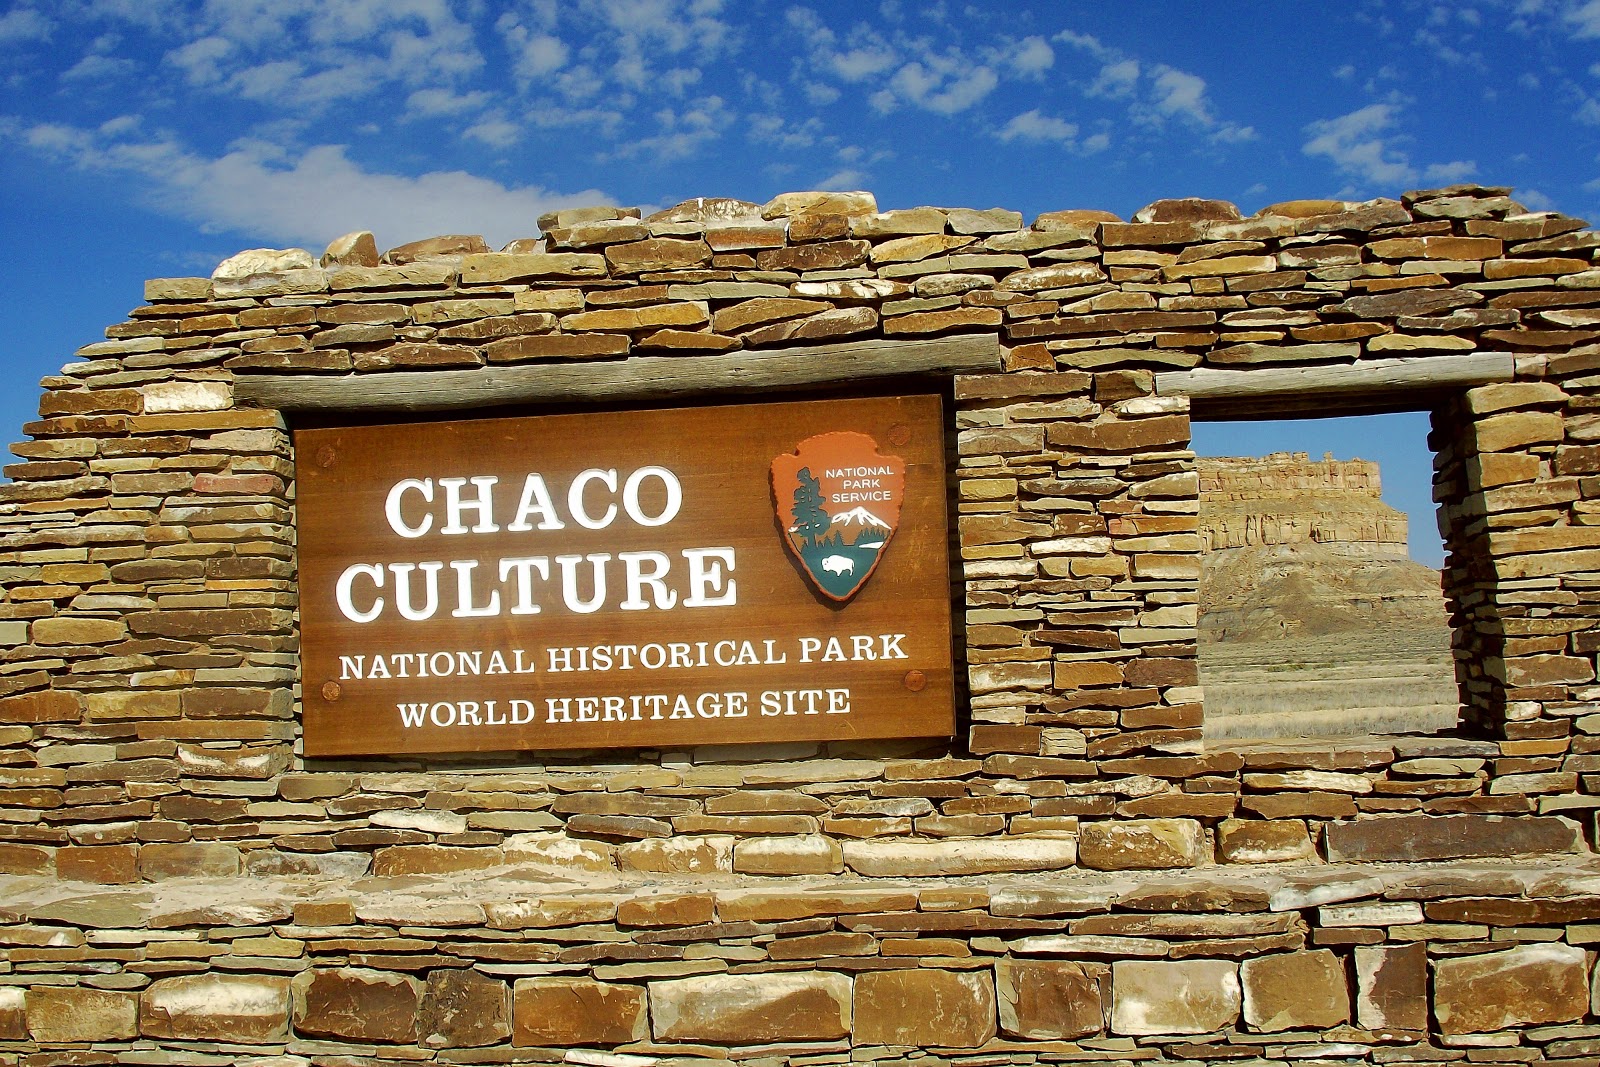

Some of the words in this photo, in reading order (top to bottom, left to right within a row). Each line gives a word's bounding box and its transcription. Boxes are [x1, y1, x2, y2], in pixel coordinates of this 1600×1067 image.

[825, 466, 894, 478] NATIONAL
[843, 479, 881, 490] PARK
[384, 465, 683, 539] CHACO
[832, 490, 892, 503] SERVICE
[335, 546, 737, 625] CULTURE
[338, 649, 535, 680] NATIONAL
[546, 639, 787, 673] HISTORICAL
[799, 633, 909, 663] PARK
[396, 699, 535, 729] WORLD
[545, 691, 749, 724] HERITAGE
[760, 688, 851, 717] SITE
